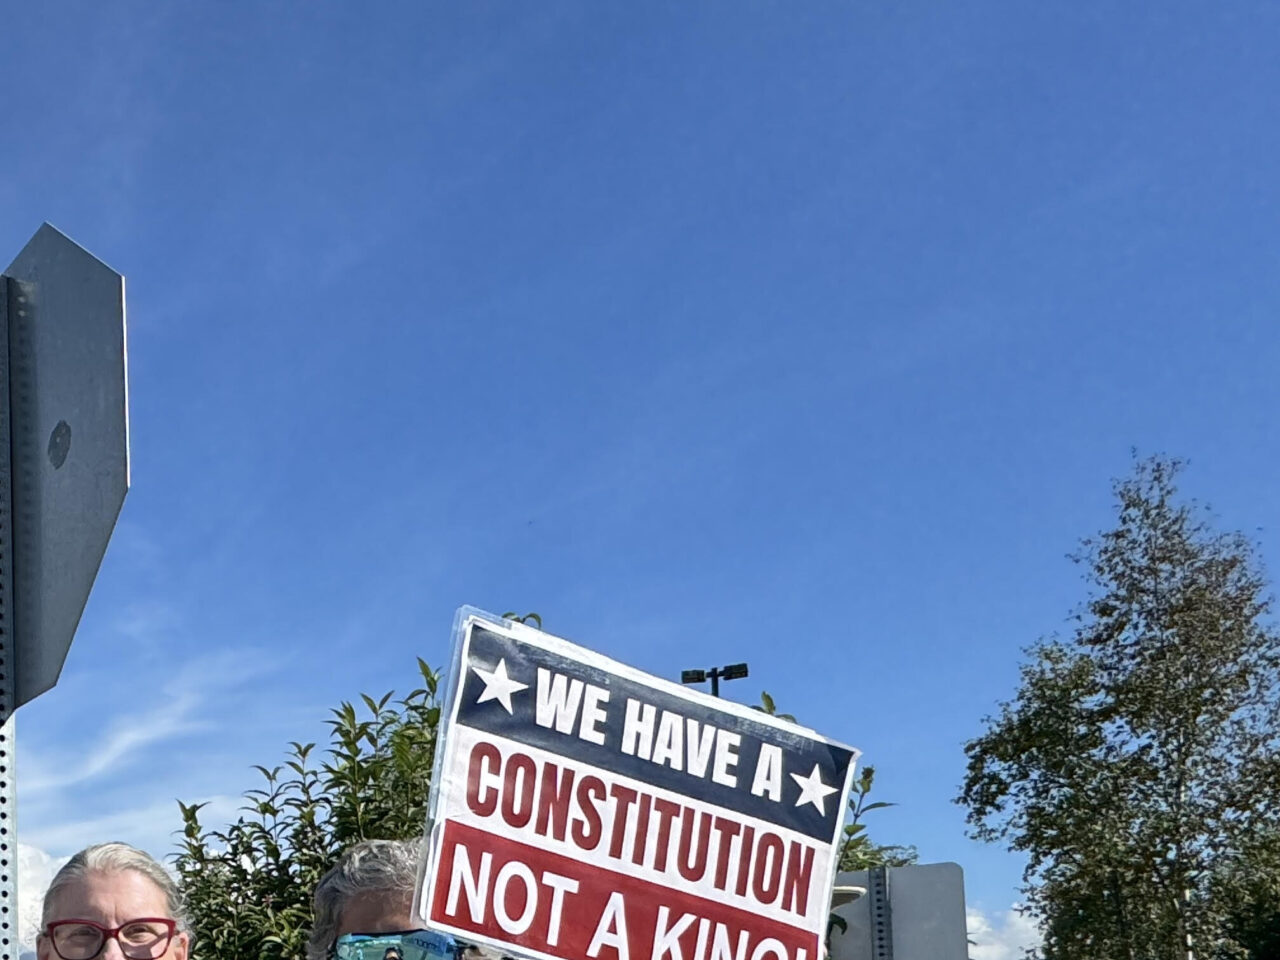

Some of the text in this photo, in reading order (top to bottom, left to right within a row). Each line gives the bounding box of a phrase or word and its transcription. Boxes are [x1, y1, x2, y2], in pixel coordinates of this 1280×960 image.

[535, 666, 784, 802] WE HAVE A
[445, 843, 580, 947] NOT
[466, 742, 815, 918] CONSTITUTION
